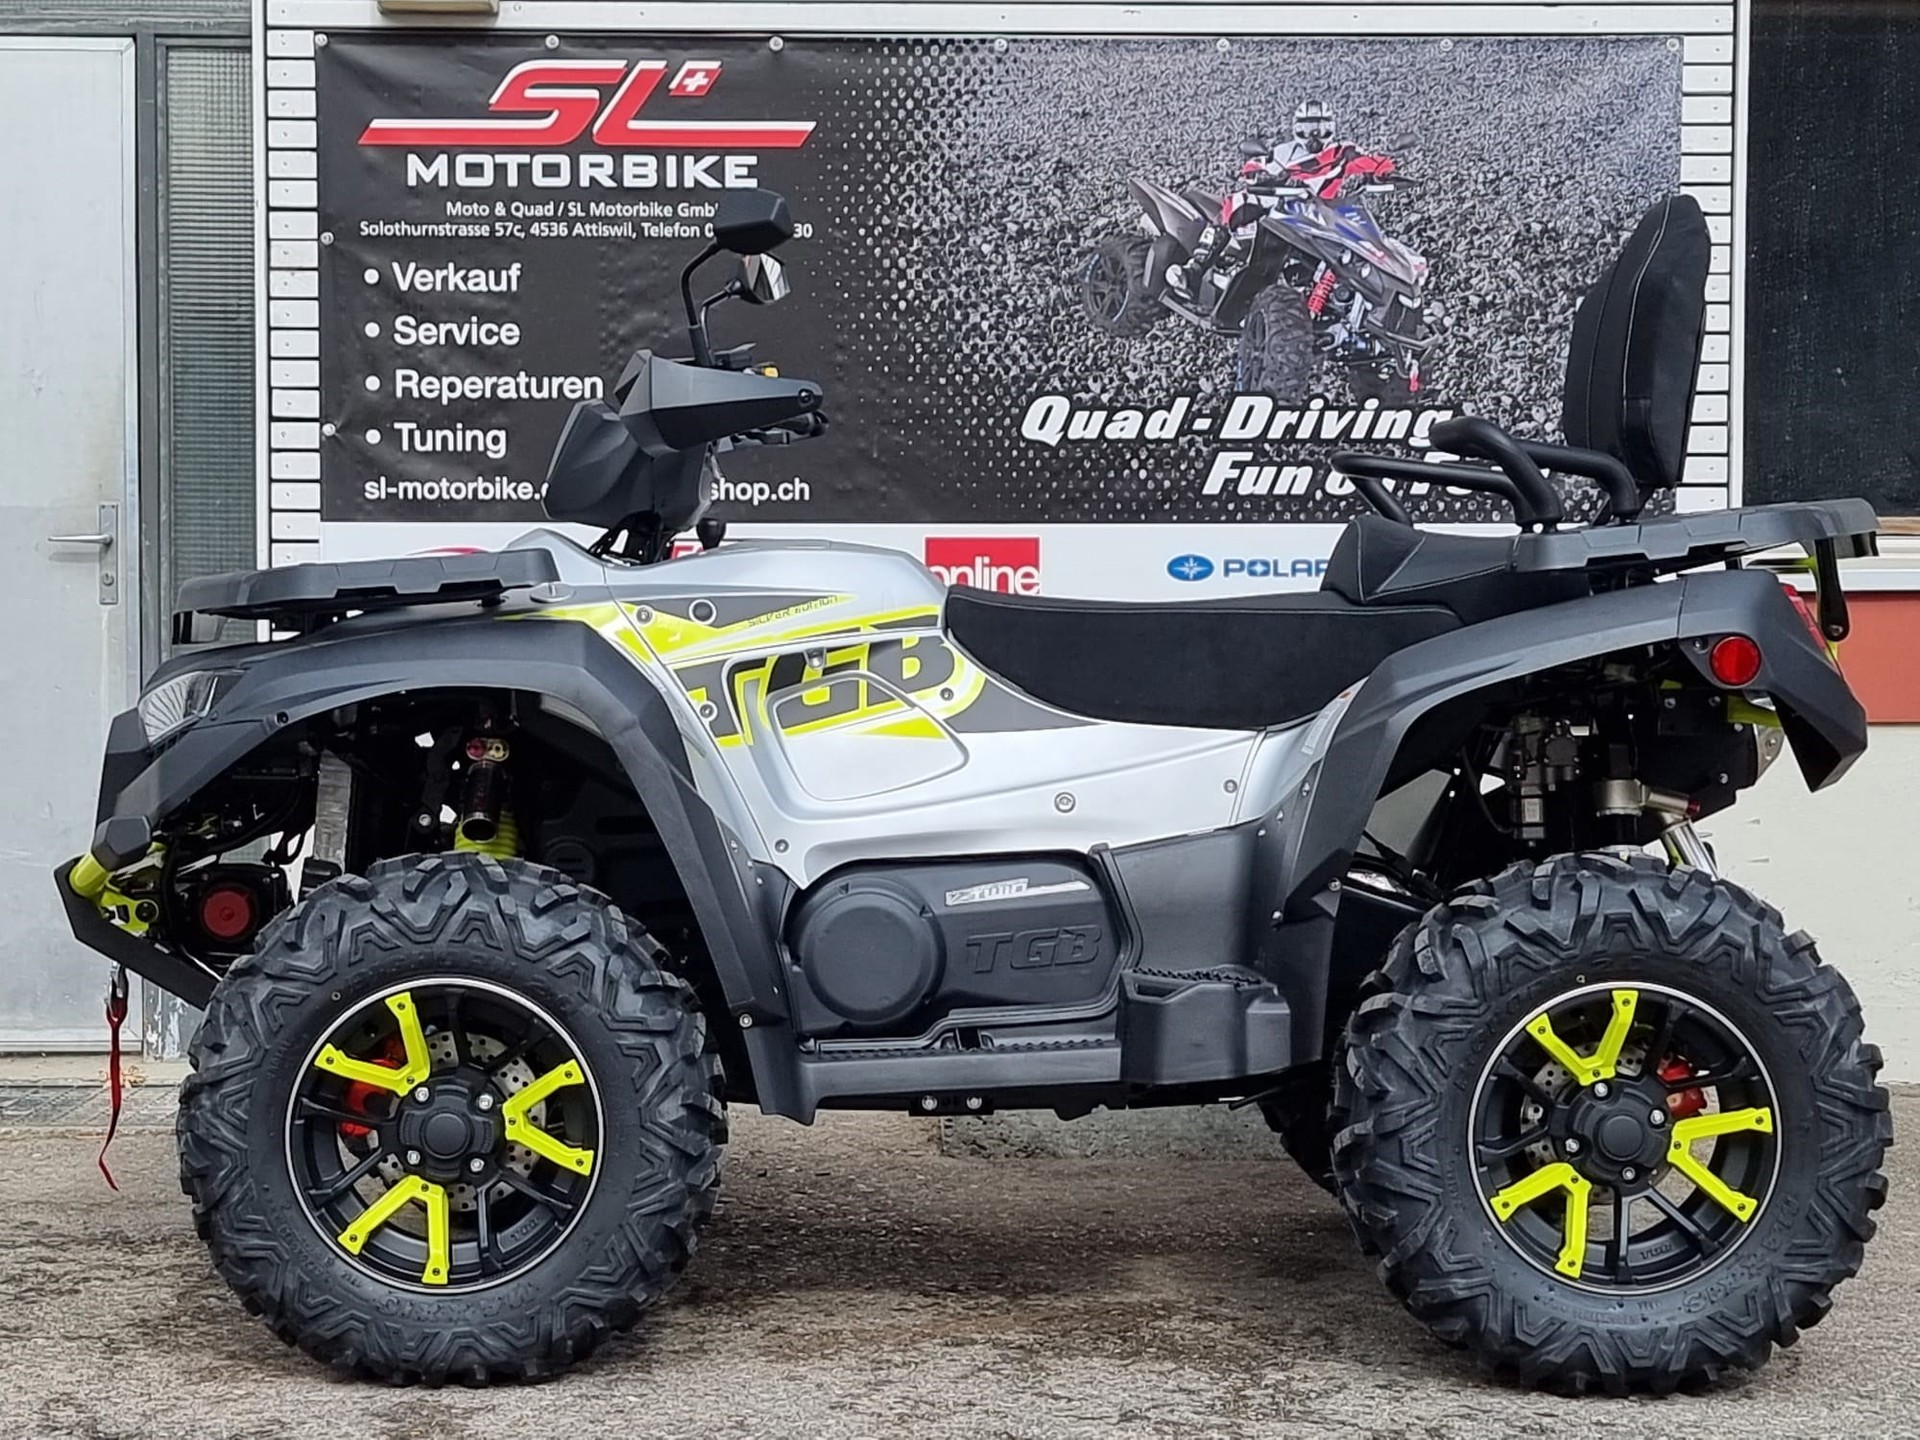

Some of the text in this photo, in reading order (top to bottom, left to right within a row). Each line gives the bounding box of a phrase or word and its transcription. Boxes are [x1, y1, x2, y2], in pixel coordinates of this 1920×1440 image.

[358, 59, 817, 147] SL
[406, 153, 758, 189] MOTORBIKE
[446, 201, 491, 217] Moto
[494, 201, 507, 218] &
[510, 201, 554, 218] Quad
[567, 202, 587, 217] SL
[590, 201, 673, 218] Motorbike
[677, 202, 719, 218] Gmb
[360, 220, 491, 237] Solothurnstrasse
[494, 221, 526, 239] 57c,
[529, 221, 568, 237] 4536
[641, 221, 701, 238] Telefon
[391, 261, 522, 293] Verkauf
[393, 315, 521, 346] Service
[395, 368, 604, 405] Reperaturen
[1021, 396, 1190, 446] Quad
[1219, 396, 1454, 447] Driving
[393, 422, 507, 459] Tuning
[1202, 452, 1313, 495] Fun
[966, 924, 1102, 974] TGB
